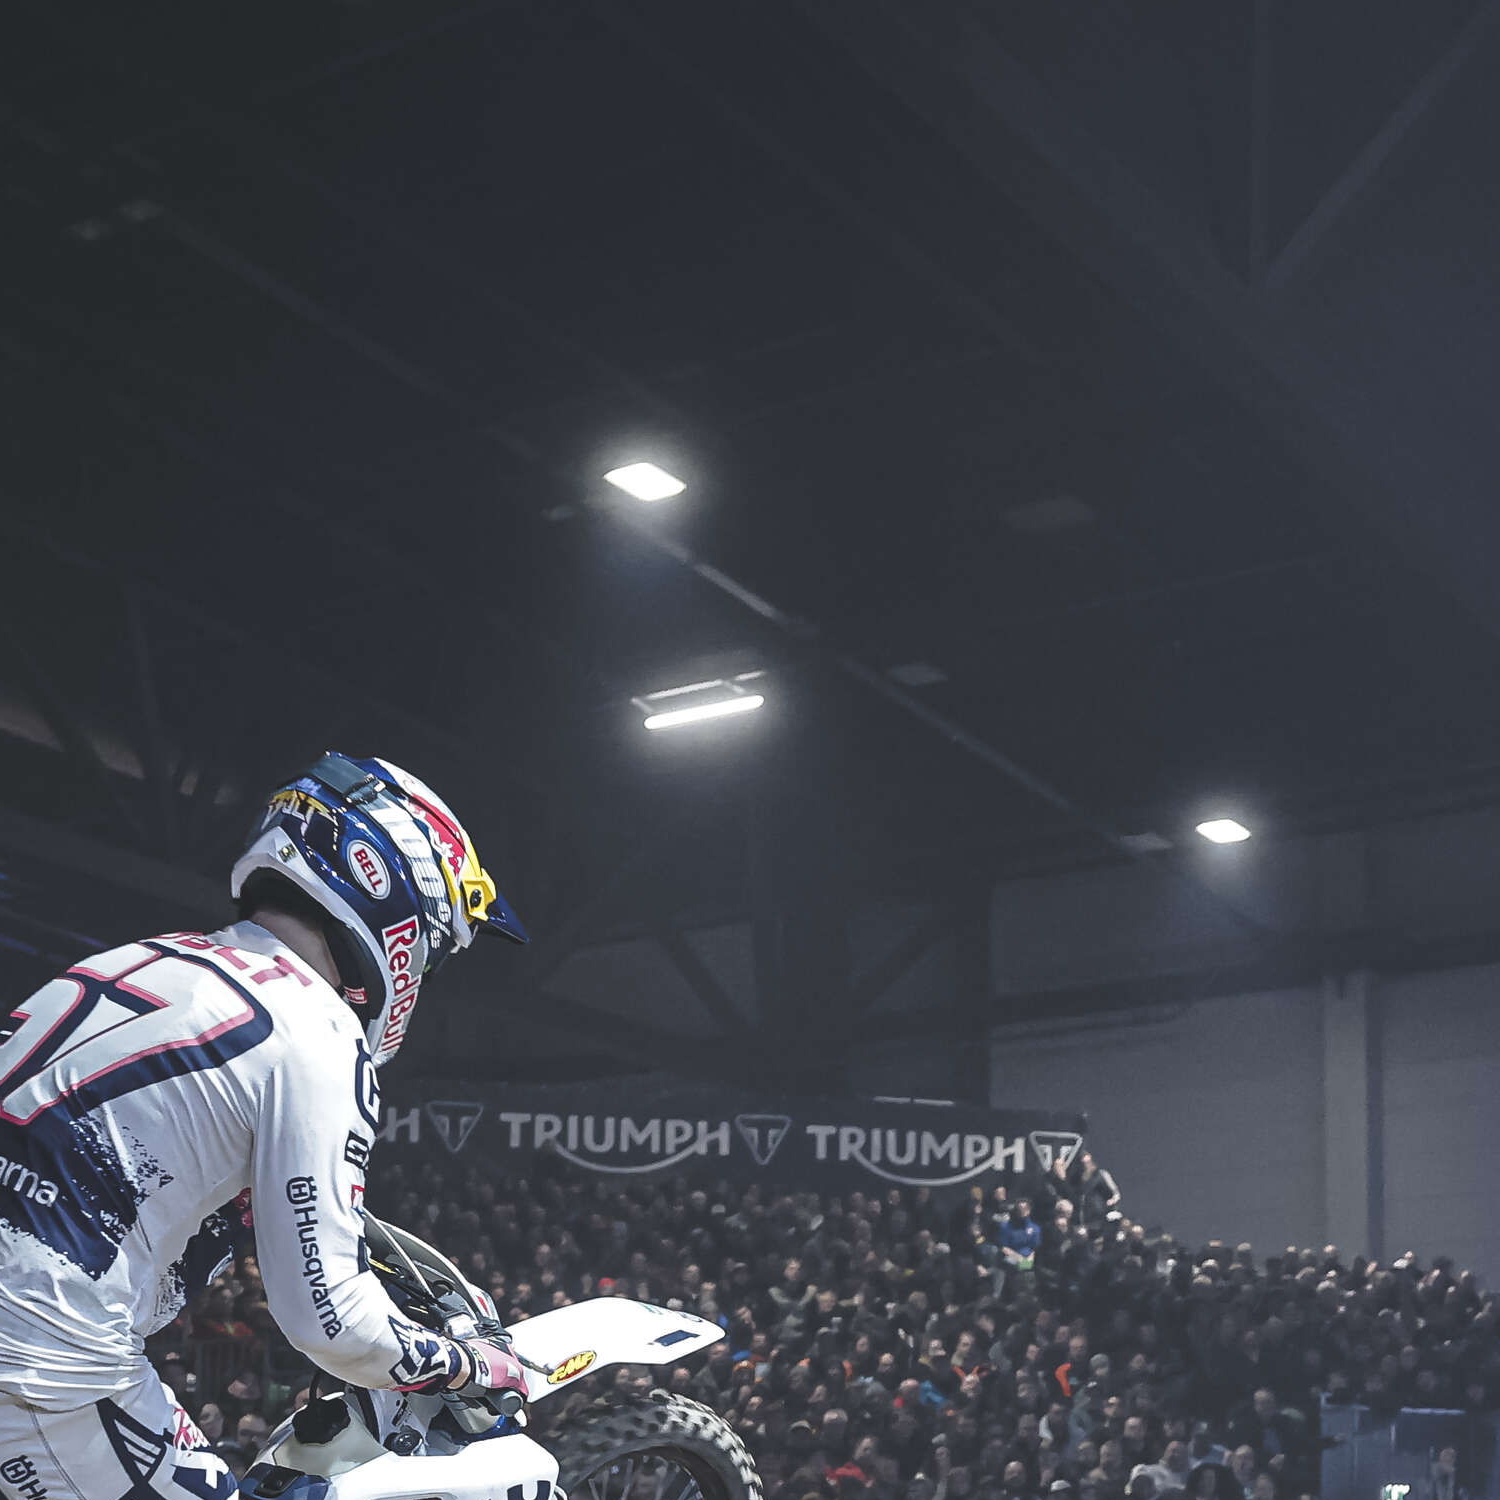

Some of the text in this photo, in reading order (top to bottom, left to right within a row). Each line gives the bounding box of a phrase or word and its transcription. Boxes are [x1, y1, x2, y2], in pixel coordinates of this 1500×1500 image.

[353, 848, 382, 892] BELL
[500, 1112, 729, 1173] TRIUMPH
[806, 1124, 1025, 1186] TRIUMPH
[294, 1205, 345, 1341] Husqvarna
[549, 1351, 596, 1383] FMF
